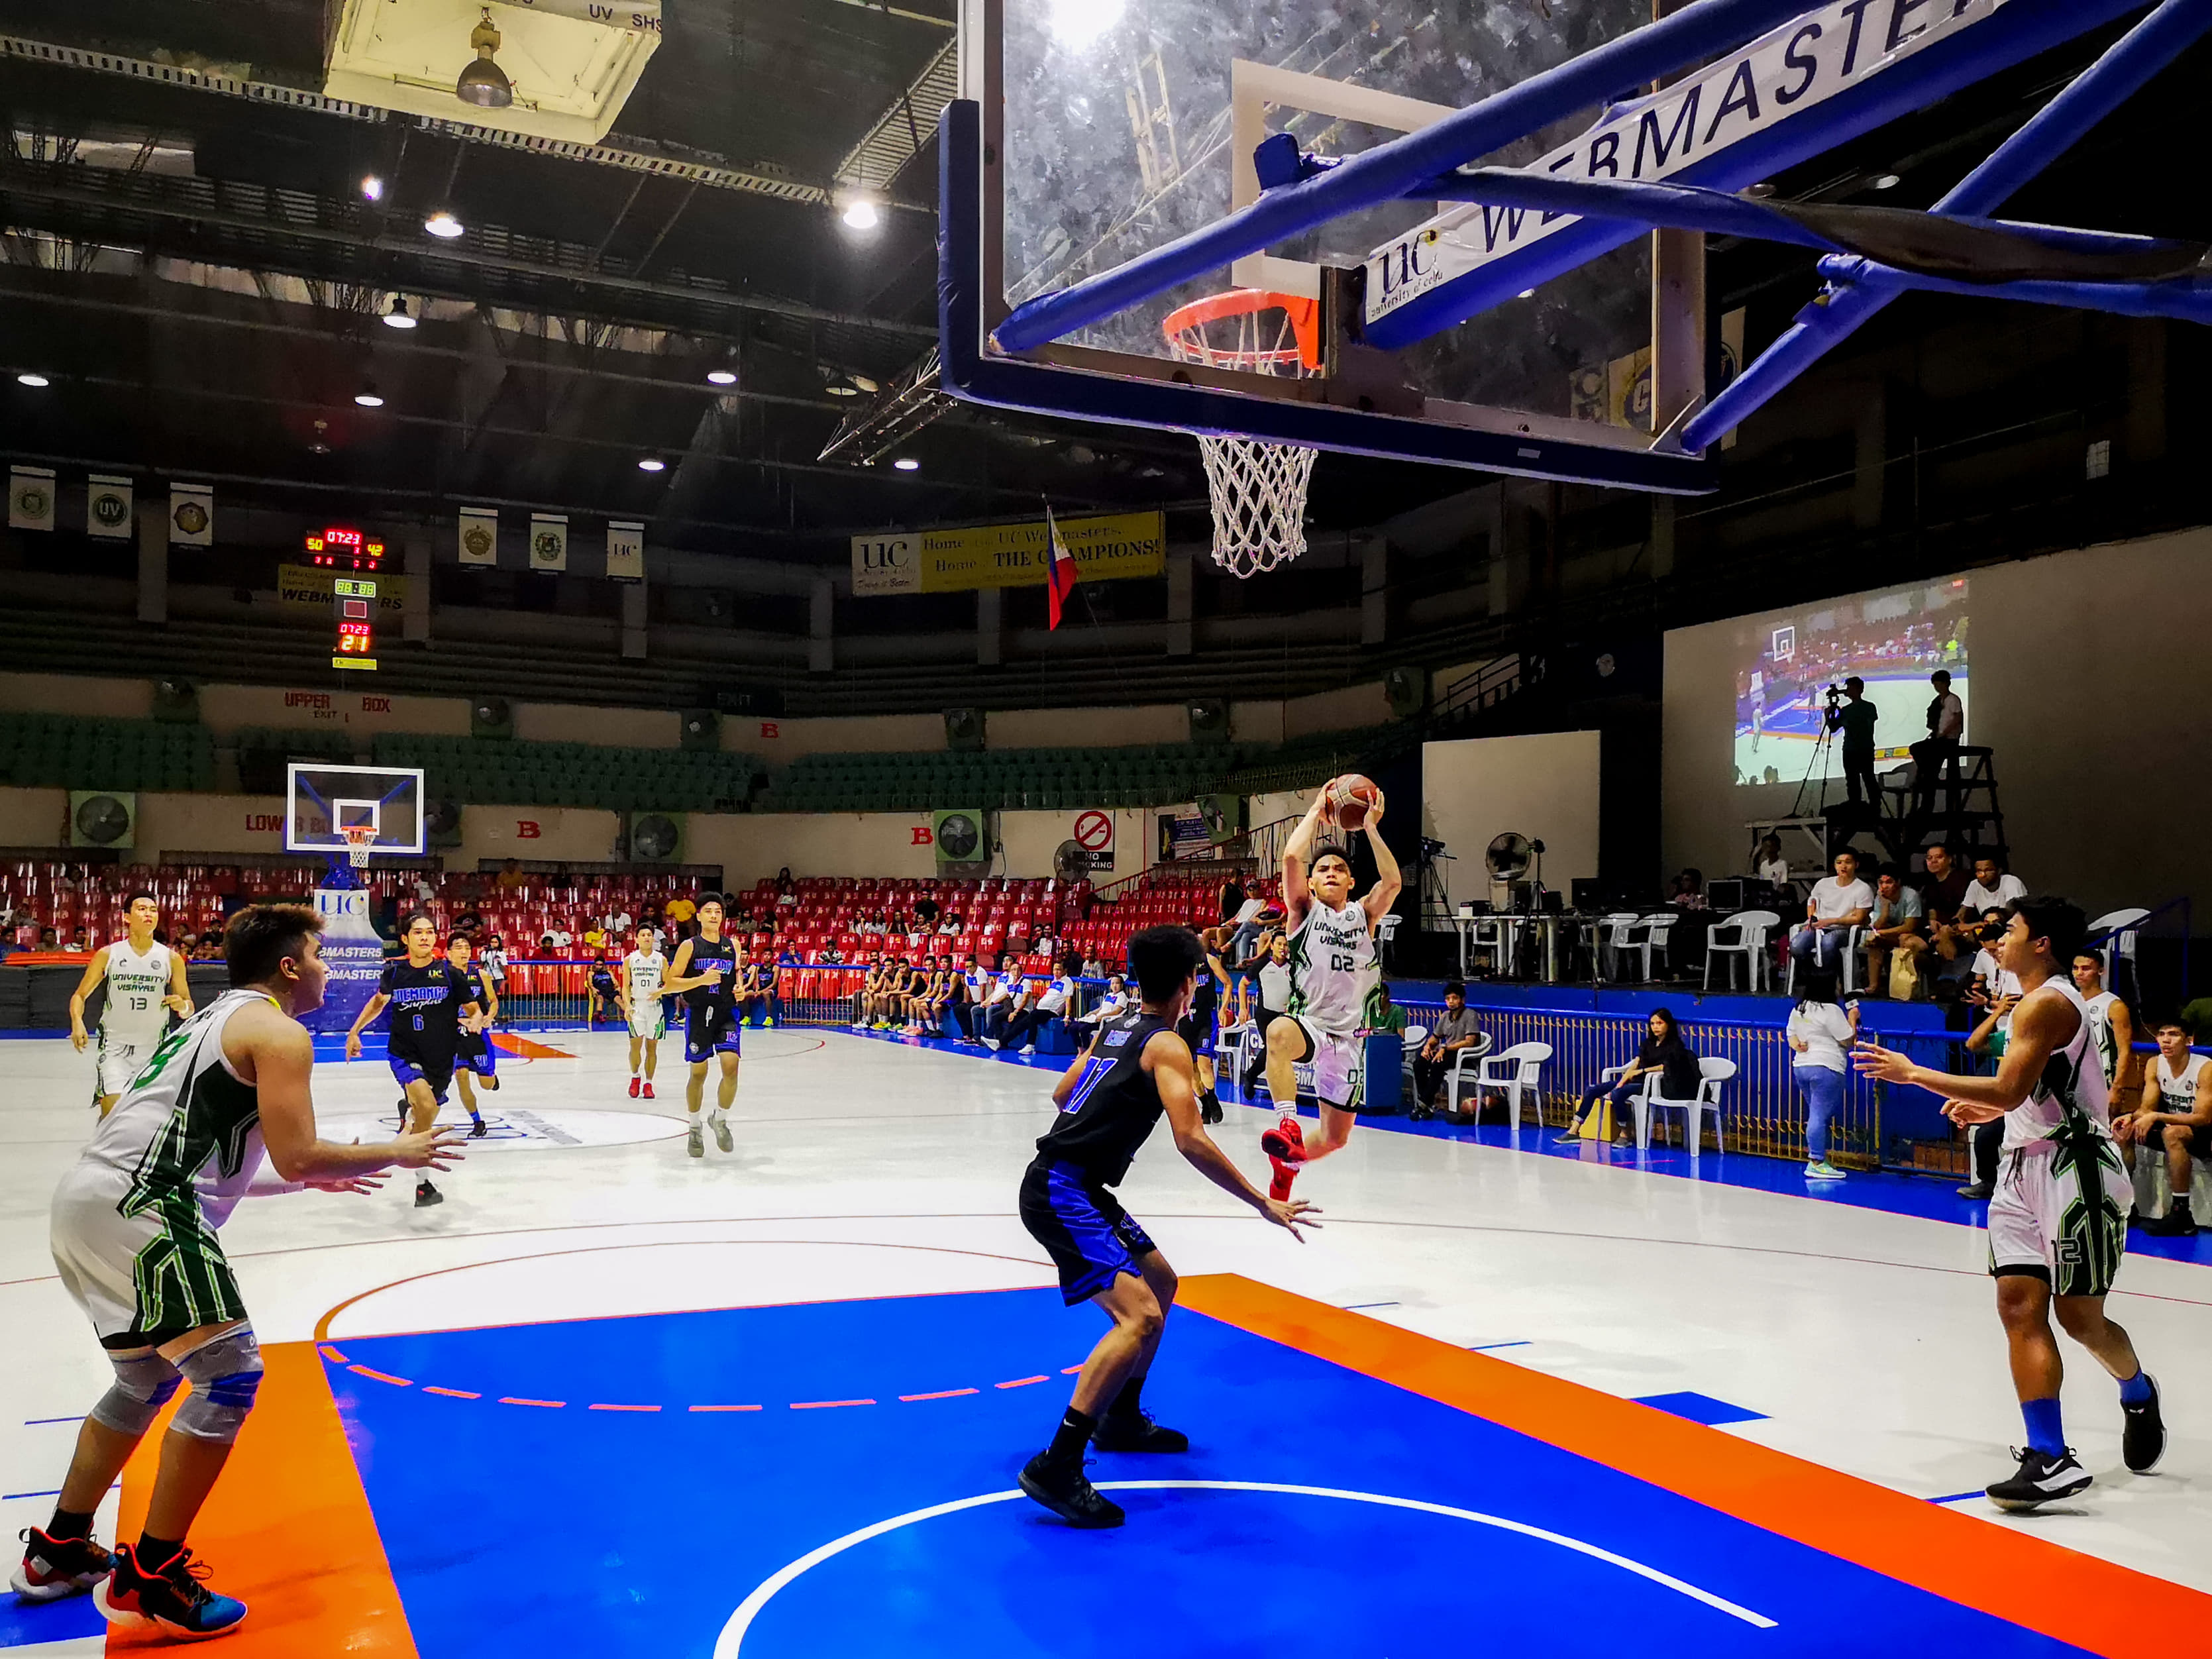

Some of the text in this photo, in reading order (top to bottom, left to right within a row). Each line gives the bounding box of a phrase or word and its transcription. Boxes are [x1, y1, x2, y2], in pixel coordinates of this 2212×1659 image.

[589, 4, 613, 21] UV
[99, 501, 121, 516] UV
[306, 538, 323, 551] 50
[327, 531, 361, 545] 07:23
[924, 539, 965, 550] Home
[367, 544, 383, 557] 42
[994, 539, 1160, 566] THE CAMPIONS!
[936, 560, 977, 572] Home
[282, 588, 402, 610] WEBMRS
[341, 635, 368, 652] 21
[285, 692, 331, 709] UPPER
[314, 710, 337, 719] EXIT
[761, 723, 778, 738] B
[246, 814, 303, 832] LOWR
[517, 820, 541, 839] B
[911, 828, 933, 845] B
[1085, 851, 1099, 861] NO
[318, 946, 382, 958] BMASTERS
[1331, 953, 1355, 972] 02
[112, 973, 165, 983] UNIVERSITY
[325, 969, 384, 980] BMASTER
[129, 997, 148, 1010] 13
[412, 1014, 424, 1032] 6
[1062, 1055, 1119, 1114] 17
[2050, 1238, 2082, 1265] 12
